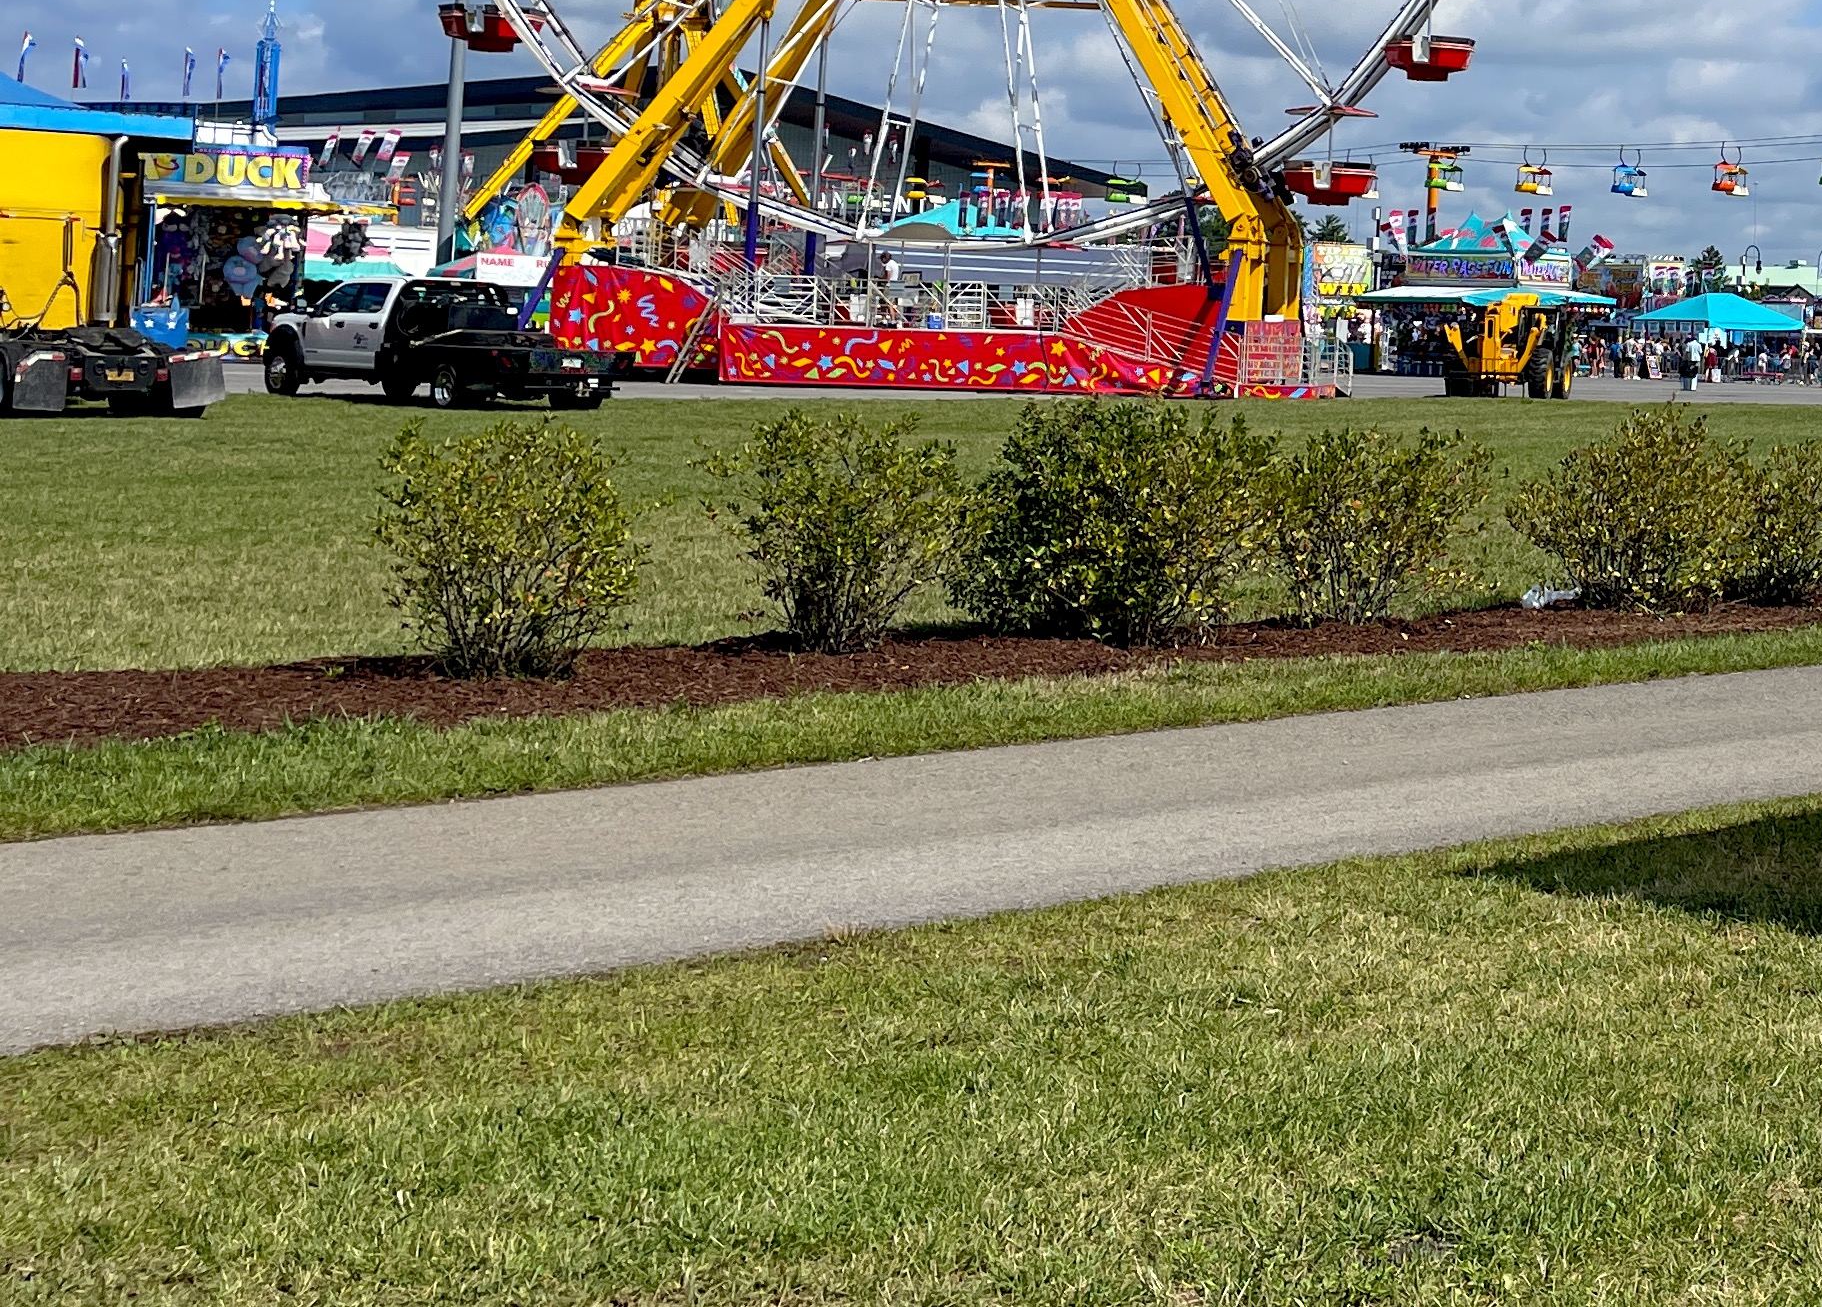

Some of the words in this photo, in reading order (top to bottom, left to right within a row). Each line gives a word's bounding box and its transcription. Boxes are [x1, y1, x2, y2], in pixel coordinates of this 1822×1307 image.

[184, 153, 303, 189] DUCK
[481, 257, 514, 267] NAME
[1318, 281, 1367, 297] WIN
